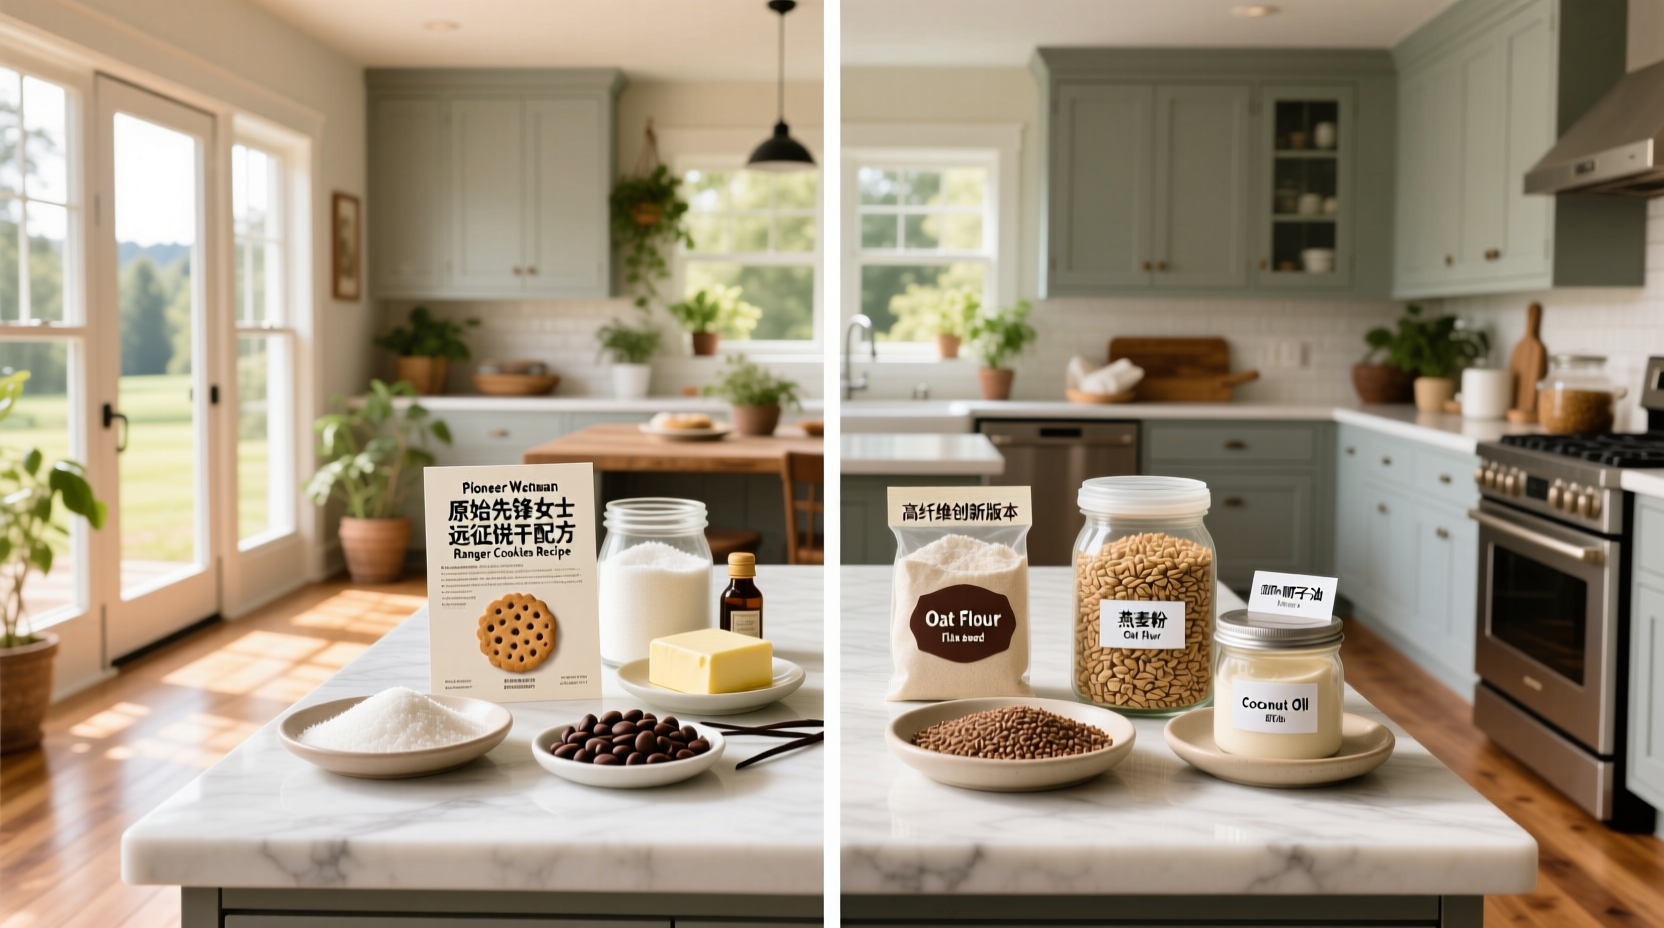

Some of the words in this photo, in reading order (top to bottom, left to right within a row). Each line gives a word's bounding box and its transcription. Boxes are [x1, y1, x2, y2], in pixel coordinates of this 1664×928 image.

[462, 482, 507, 494] Pioneer
[902, 502, 1019, 522] 高纤维创新版本
[454, 548, 491, 561] Ranger
[537, 546, 571, 560] Recipe
[925, 609, 955, 627] Oat
[959, 609, 1002, 627] Flour
